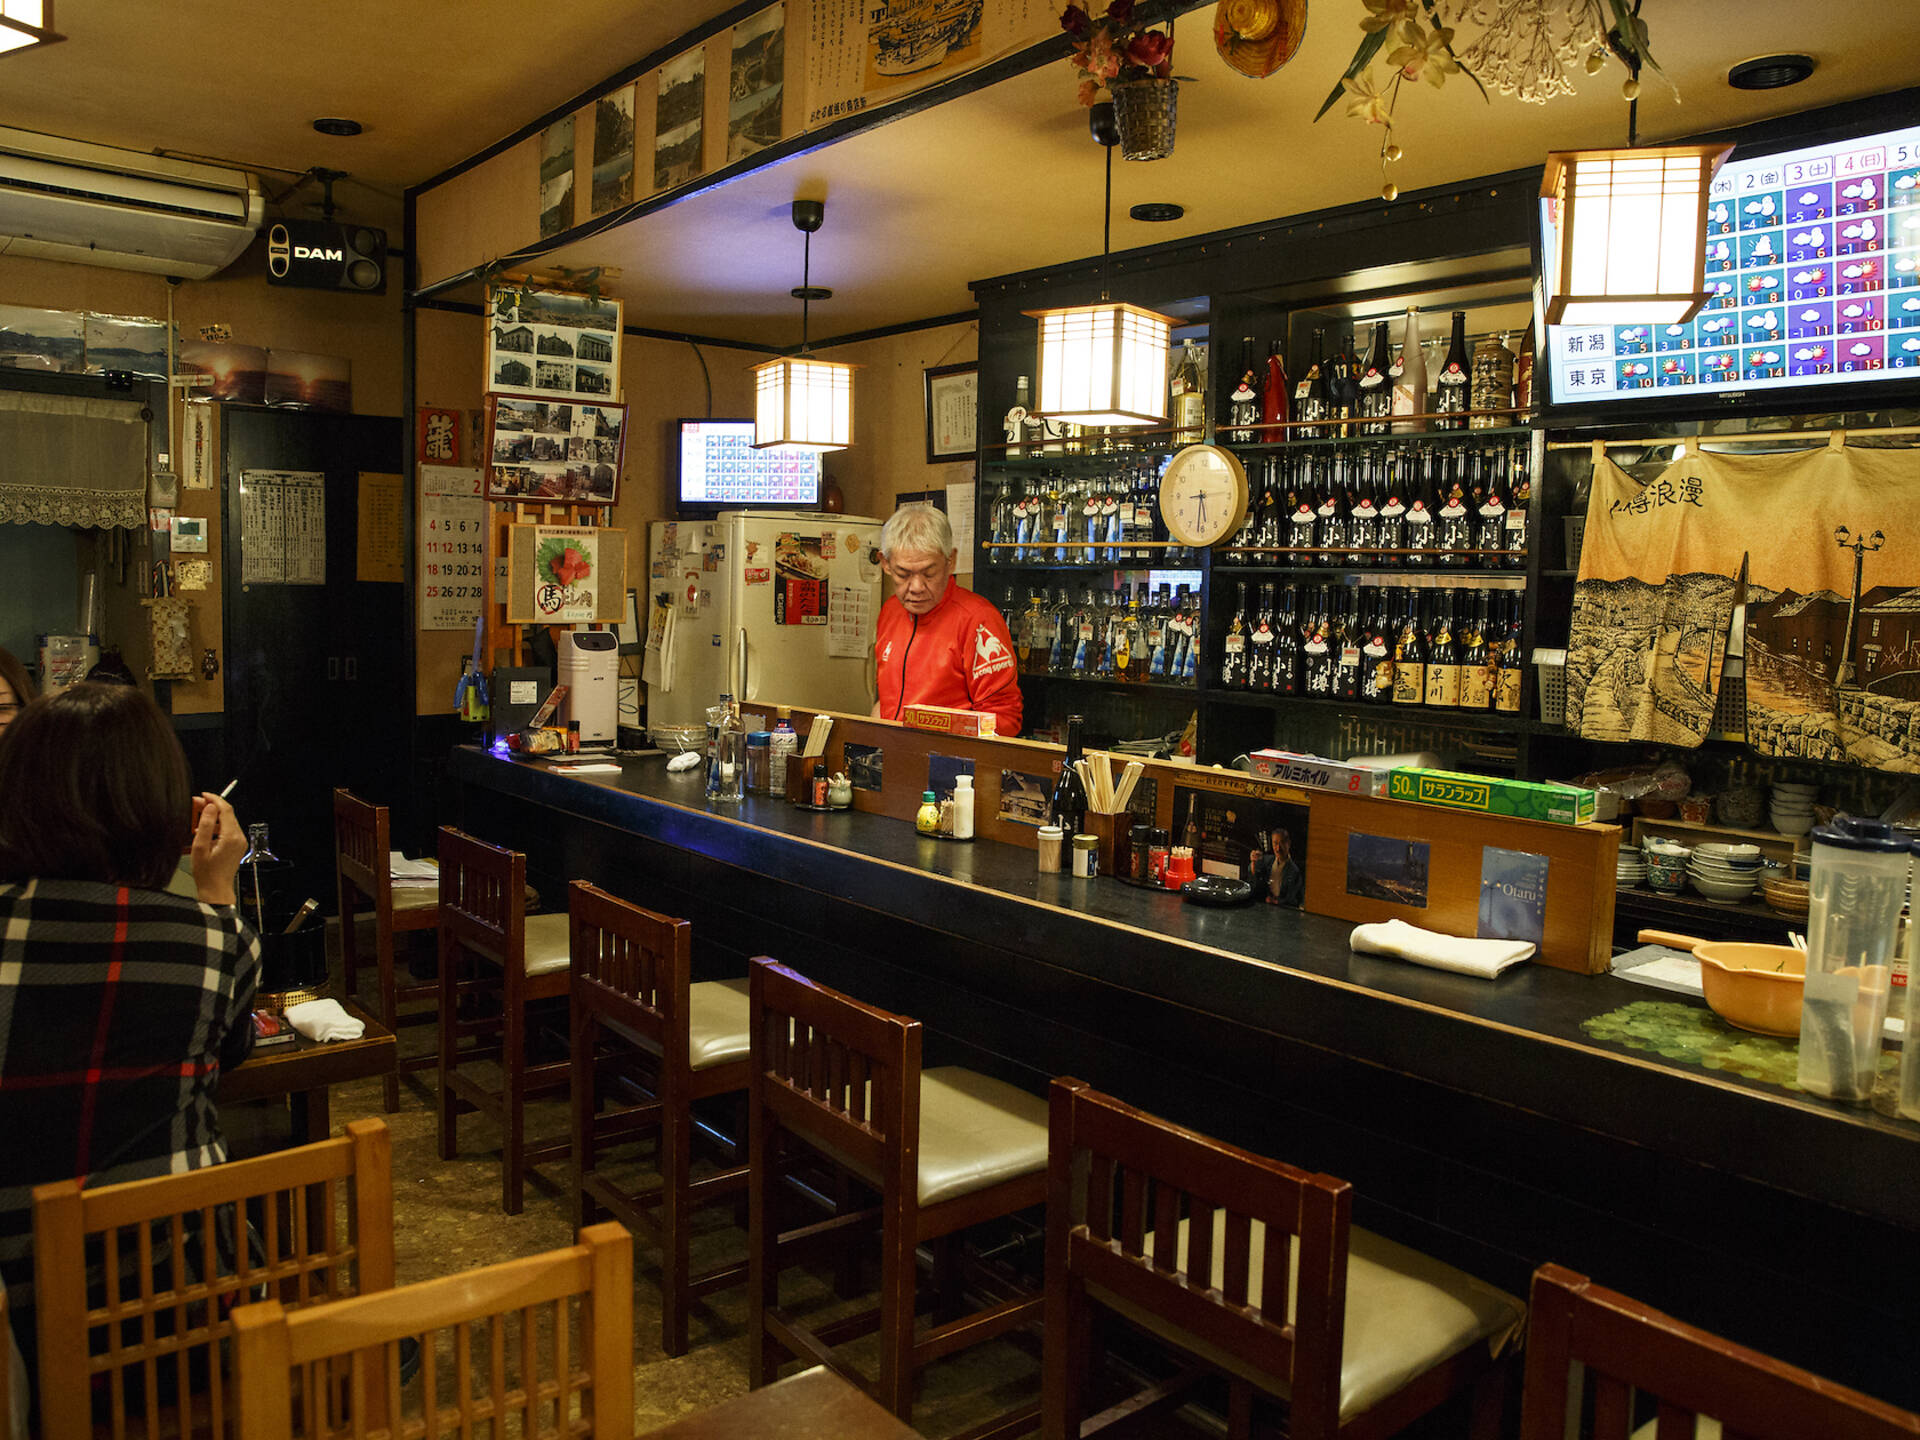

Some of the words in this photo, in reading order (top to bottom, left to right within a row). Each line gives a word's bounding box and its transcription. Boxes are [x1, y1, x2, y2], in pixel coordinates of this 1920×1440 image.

[1721, 223, 1730, 233] 6
[1744, 219, 1756, 229] -4
[1766, 215, 1778, 226] -1
[1791, 212, 1804, 222] -5
[1816, 208, 1825, 219] 2
[1840, 203, 1854, 214] -3
[1867, 199, 1877, 211] 5
[294, 246, 343, 262] DAM
[1722, 260, 1731, 271] 9
[1745, 257, 1757, 268] -2
[1768, 254, 1777, 265] 2
[1792, 250, 1805, 261] -3
[1817, 247, 1826, 258] 6
[1841, 243, 1854, 254] -1
[1867, 240, 1878, 251] 6
[1721, 297, 1736, 308] 13
[1747, 295, 1756, 305] 0
[1769, 292, 1779, 303] 8
[1794, 289, 1803, 300] 0
[1817, 286, 1826, 297] 9
[1843, 283, 1853, 295] 2
[1865, 280, 1880, 291] 11
[1568, 334, 1604, 353] 新潟
[1639, 343, 1648, 353] 5
[1661, 341, 1669, 352] 3
[1680, 339, 1690, 349] 8
[1703, 337, 1712, 347] 4
[1721, 334, 1736, 345] 11
[1769, 330, 1779, 341] 5
[1815, 325, 1829, 336] 11
[1843, 322, 1853, 334] 2
[1864, 320, 1881, 331] 10
[1569, 368, 1606, 387] 東京
[1621, 380, 1629, 390] 2
[1639, 377, 1653, 388] 10
[1662, 376, 1670, 387] 2
[1679, 374, 1695, 385] 14
[1704, 373, 1713, 384] 8
[1722, 371, 1738, 382] 19
[1749, 369, 1757, 380] 6
[1767, 367, 1784, 378] 14
[1795, 365, 1804, 376] 4
[1815, 363, 1832, 375] 12
[1843, 361, 1853, 372] 6
[1864, 359, 1881, 370] 15
[1895, 357, 1904, 368] 6
[473, 479, 481, 494] 2
[429, 519, 436, 531] 4
[444, 520, 451, 532] 5
[459, 520, 466, 532] 6
[474, 521, 480, 533] 7
[427, 542, 438, 554] 11
[442, 542, 453, 554] 12
[456, 542, 468, 554] 13
[471, 542, 482, 554] 14
[427, 564, 438, 576] 18
[442, 564, 453, 576] 19
[456, 564, 468, 576] 20
[471, 564, 482, 576] 21
[427, 586, 438, 598] 25
[442, 586, 453, 598] 26
[456, 586, 468, 598] 27
[471, 586, 482, 598] 28
[1431, 667, 1444, 702] 早川
[1272, 764, 1331, 786] アルミホイル
[1425, 782, 1485, 803] サランラップ
[1503, 883, 1536, 900] Otaru
